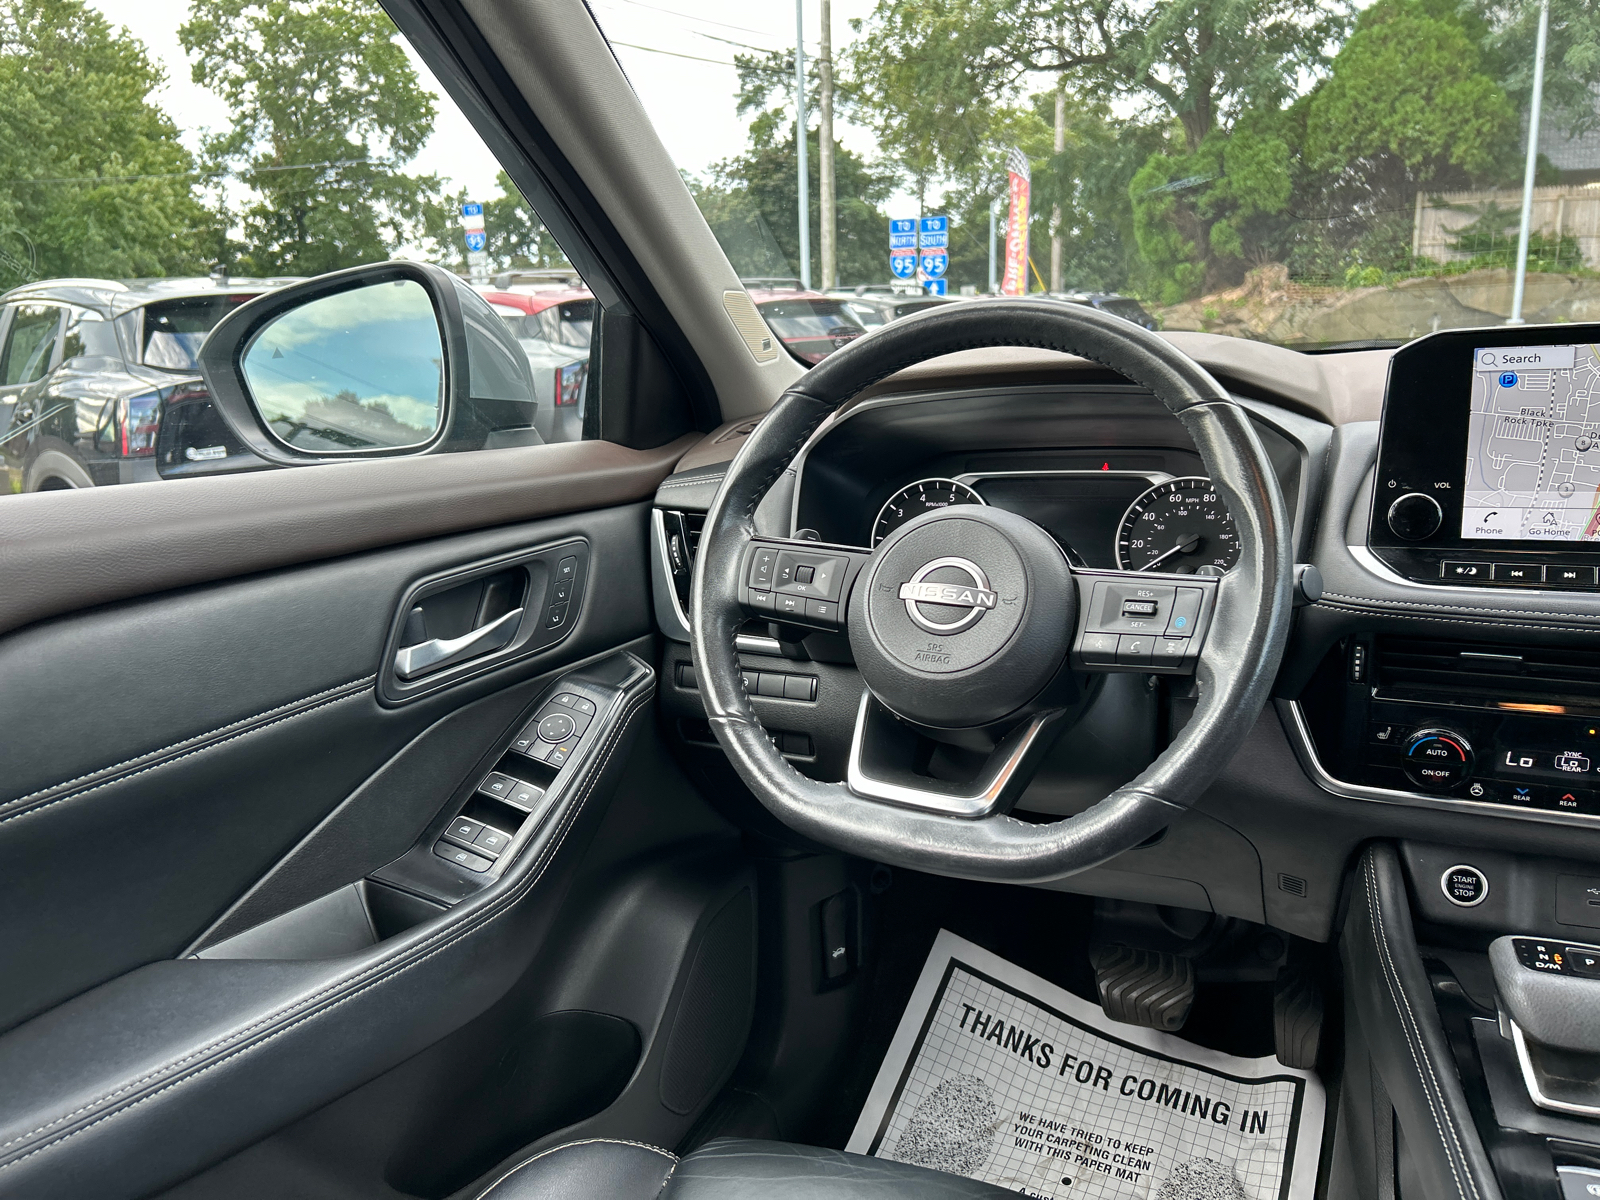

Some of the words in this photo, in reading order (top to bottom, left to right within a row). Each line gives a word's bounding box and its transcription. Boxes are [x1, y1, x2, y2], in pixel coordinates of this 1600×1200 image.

[897, 221, 911, 231] TO
[926, 219, 941, 230] TO
[890, 235, 916, 247] NORTH
[920, 234, 947, 246] SOUTH
[894, 258, 914, 273] 95
[923, 258, 945, 273] 95
[1502, 353, 1541, 364] Search
[1520, 408, 1546, 418] Black
[1504, 416, 1527, 425] Rock
[1530, 419, 1554, 428] Tpke
[920, 494, 926, 502] 4
[949, 494, 955, 502] 5
[1169, 494, 1182, 502] 60
[1203, 494, 1216, 502] 80
[897, 509, 904, 518] 3
[1142, 512, 1155, 521] 40
[1475, 527, 1503, 535] Phone
[1529, 529, 1542, 537] Go
[1131, 540, 1144, 548] 20
[901, 585, 994, 607] NISSAN
[1125, 603, 1151, 611] CANCEL
[926, 642, 944, 652] SRS
[914, 652, 951, 665] AIRBAG
[1426, 748, 1448, 757] AUTO
[1505, 751, 1533, 768] Lo
[1562, 765, 1582, 773] REAR
[1513, 794, 1531, 802] REAR
[1452, 875, 1477, 884] START
[1454, 889, 1475, 897] STOP
[1535, 961, 1561, 970] D/M
[959, 1003, 1054, 1068] THANKS
[1059, 1053, 1113, 1091] FOR
[1120, 1075, 1231, 1126] COMING
[1239, 1109, 1269, 1135] IN
[1019, 1111, 1037, 1124] WE
[1038, 1117, 1067, 1134] HAVE
[1070, 1126, 1103, 1145] TRIED
[1107, 1137, 1121, 1149] TO
[1124, 1141, 1154, 1157] KEEP
[1014, 1123, 1044, 1140] YOUR
[1046, 1133, 1110, 1160] CARPETING
[1112, 1153, 1151, 1171] CLEAN
[1014, 1136, 1043, 1153] WITH
[1047, 1145, 1072, 1161] THIS
[1074, 1154, 1112, 1175] PAPER
[1115, 1167, 1141, 1183] MAT
